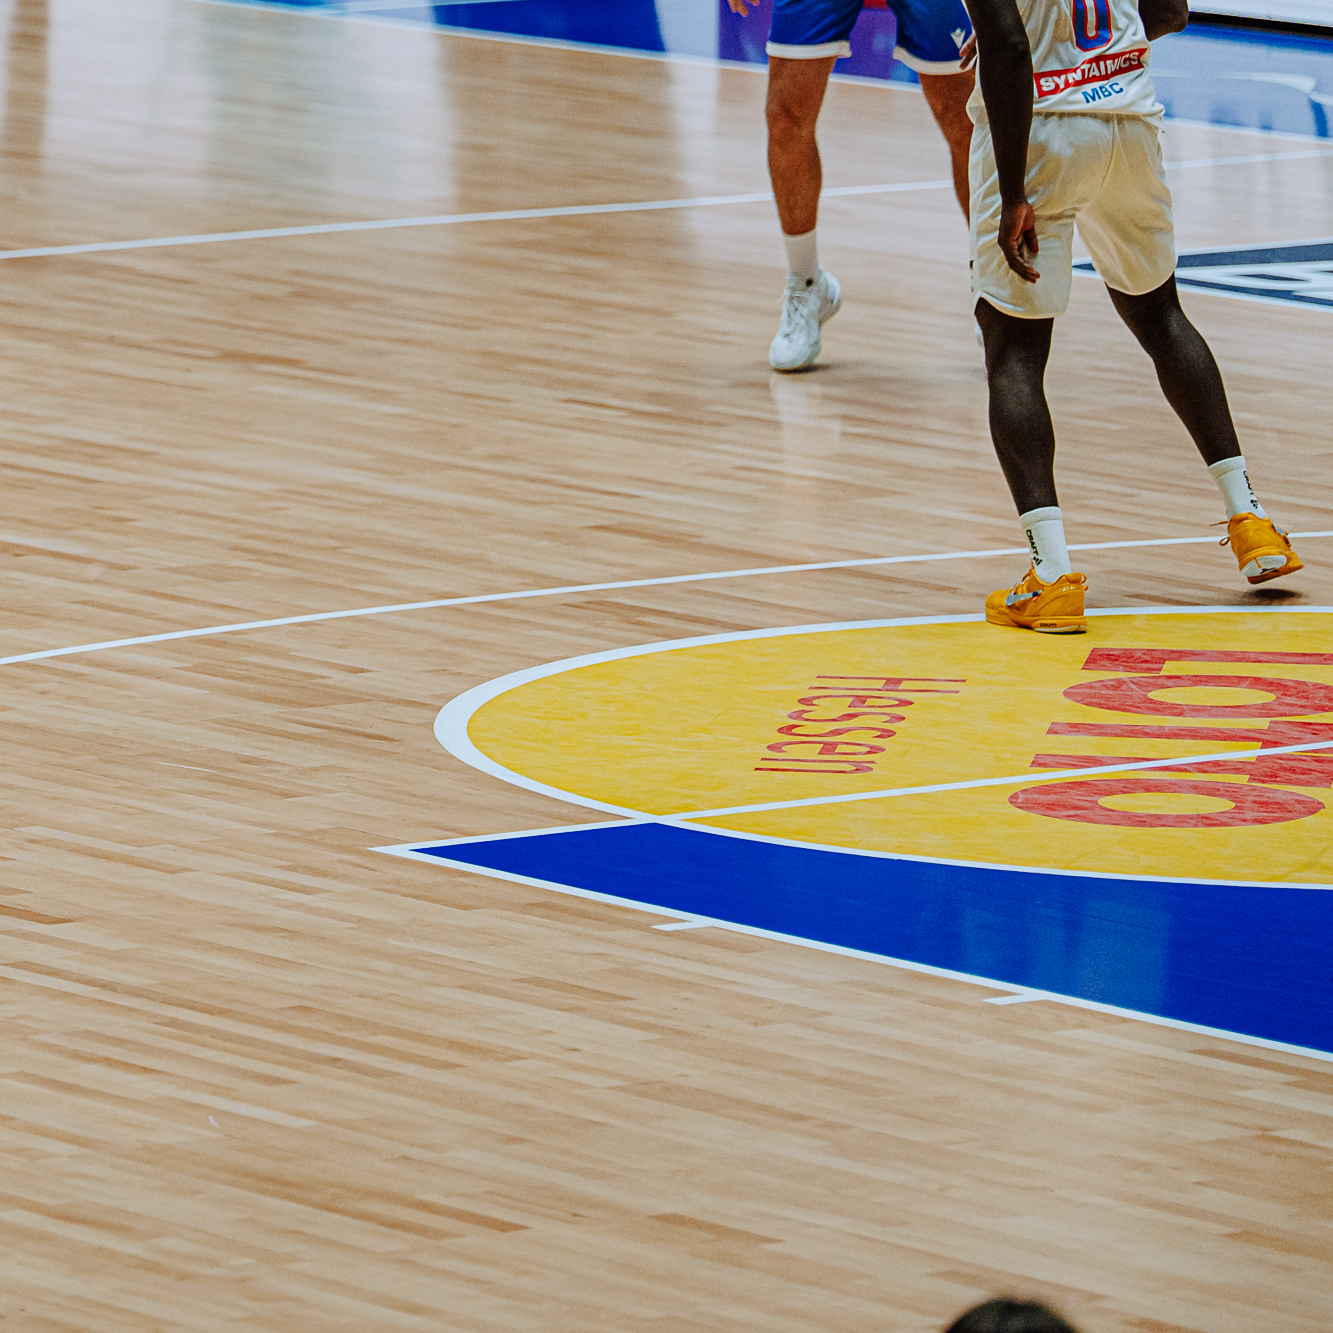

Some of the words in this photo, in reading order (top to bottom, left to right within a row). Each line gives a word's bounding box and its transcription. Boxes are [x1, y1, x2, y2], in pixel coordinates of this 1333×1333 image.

[1081, 82, 1124, 104] MBC
[754, 675, 967, 774] Hessen
[1008, 647, 1333, 828] LOTTO
